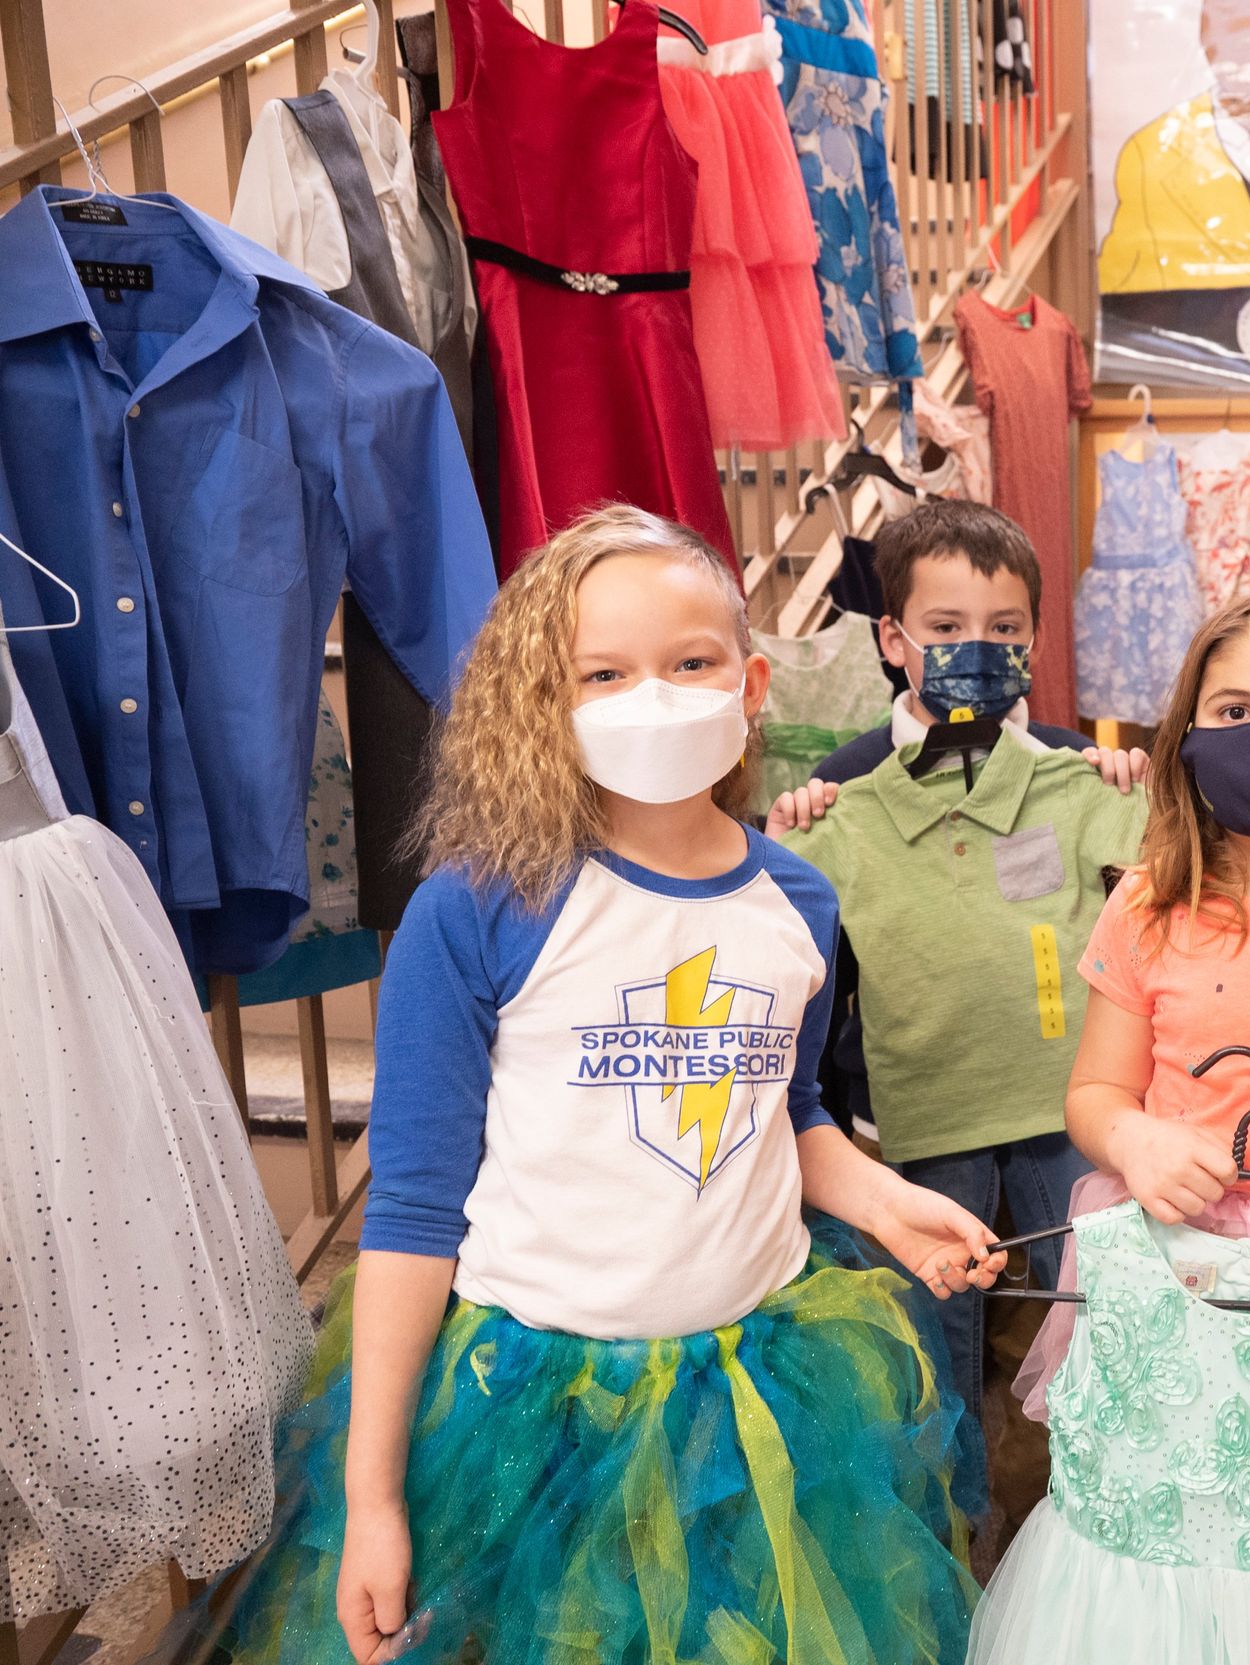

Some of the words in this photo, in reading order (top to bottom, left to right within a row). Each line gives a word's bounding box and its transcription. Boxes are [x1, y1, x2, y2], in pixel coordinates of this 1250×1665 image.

[581, 1030, 709, 1050] SPOKANE
[719, 1031, 793, 1049] PUBLIC
[577, 1054, 786, 1079] MONTESSORI
